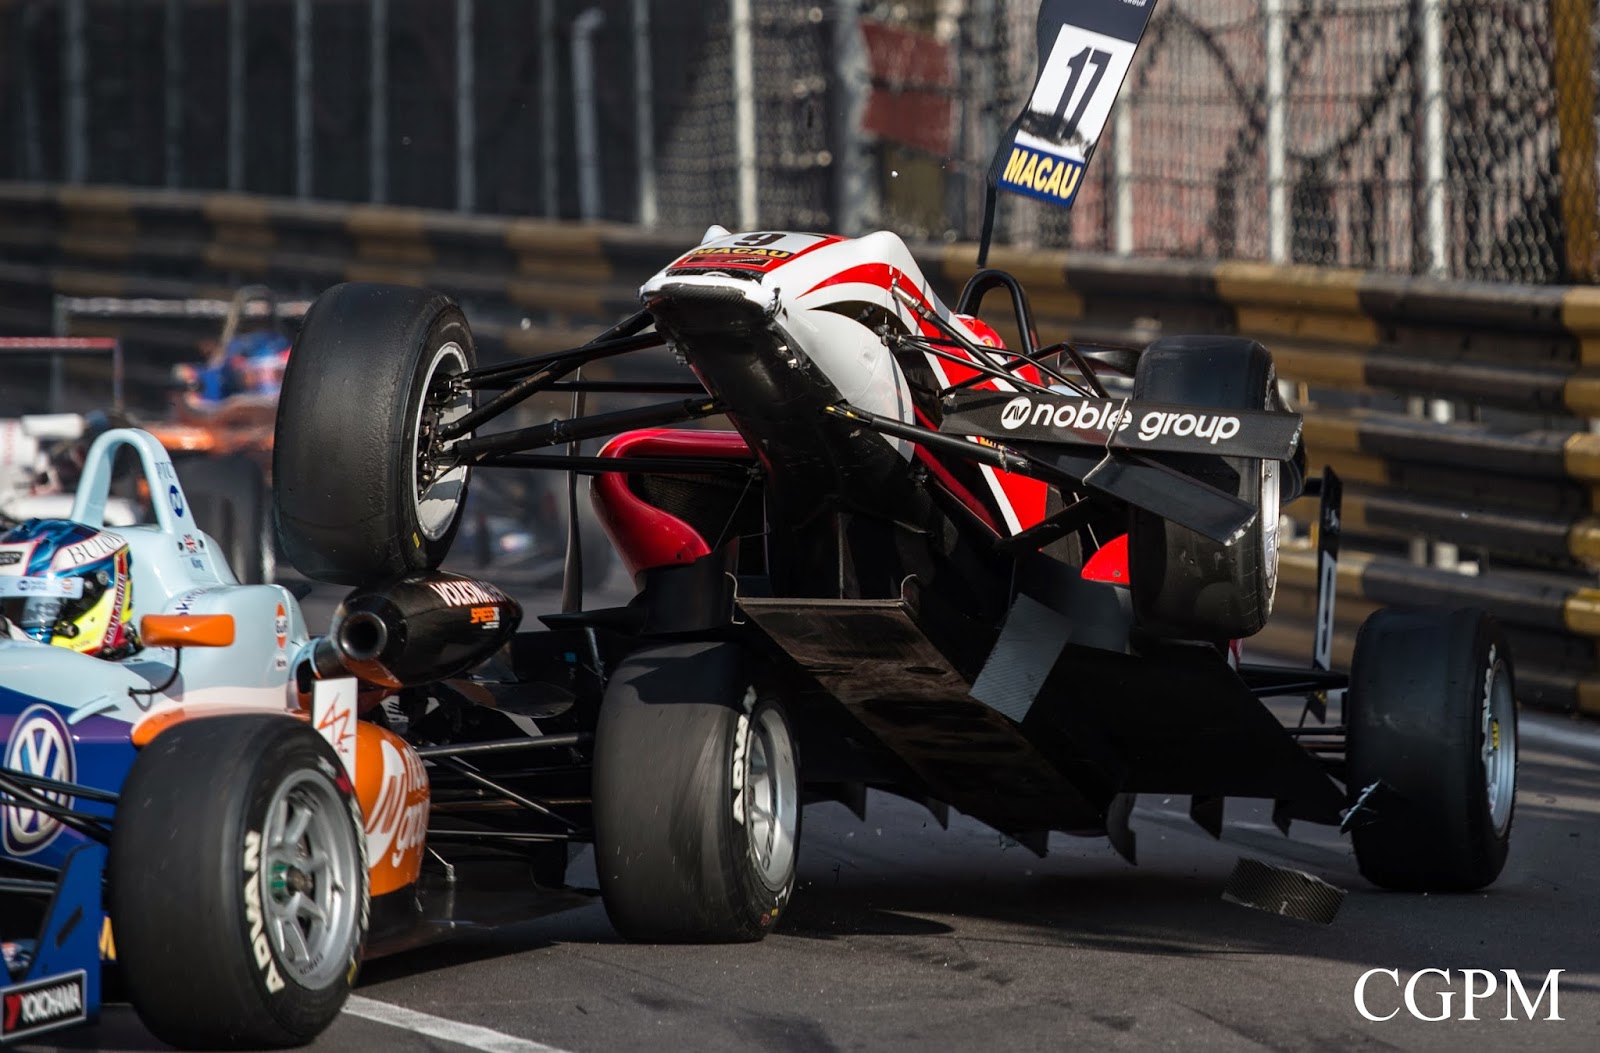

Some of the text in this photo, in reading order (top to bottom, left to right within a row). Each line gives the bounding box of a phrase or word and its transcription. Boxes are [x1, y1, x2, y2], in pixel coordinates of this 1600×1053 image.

[1051, 46, 1113, 139] 17
[1002, 147, 1081, 199] MACAU
[692, 247, 790, 258] MACAU
[733, 233, 787, 247] 9
[1031, 400, 1241, 444] noble group
[733, 685, 757, 826] ADVAN
[243, 830, 286, 994] ADVAN
